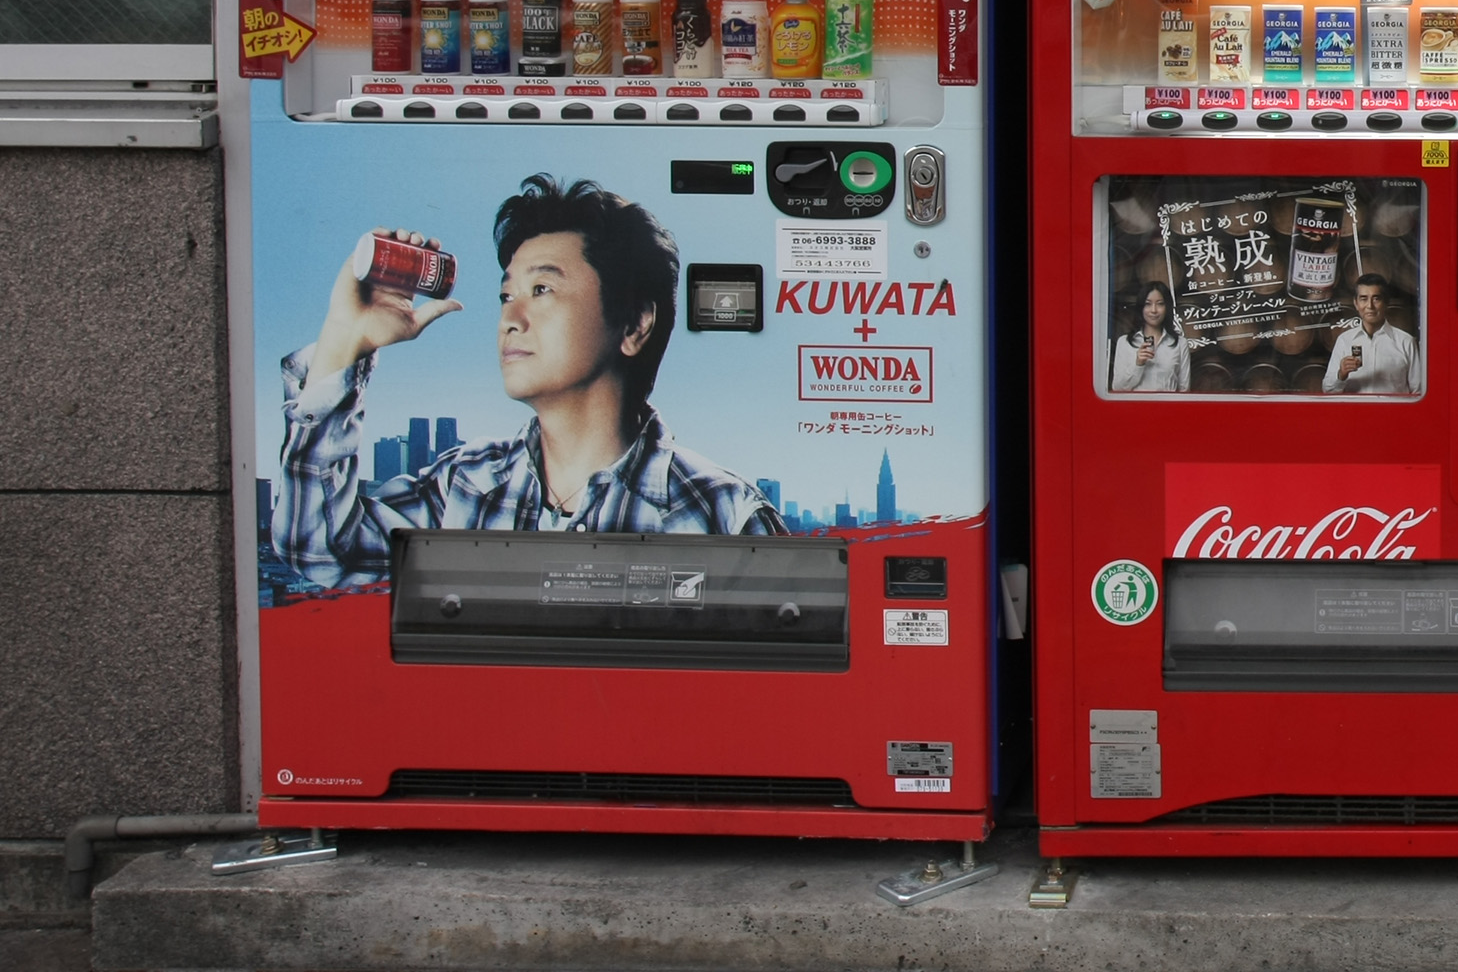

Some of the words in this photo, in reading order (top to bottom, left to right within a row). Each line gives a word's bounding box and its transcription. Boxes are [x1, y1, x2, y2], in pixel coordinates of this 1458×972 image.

[1180, 210, 1269, 235] はじめての
[1296, 217, 1338, 230] GEORGIA
[1182, 230, 1273, 278] 熟成
[775, 280, 957, 316] KUWATA
[810, 355, 922, 381] WONDA
[809, 383, 865, 392] WONDERFUL
[869, 384, 904, 393] COFFEE
[830, 411, 903, 421] 朝専用缶コーヒー
